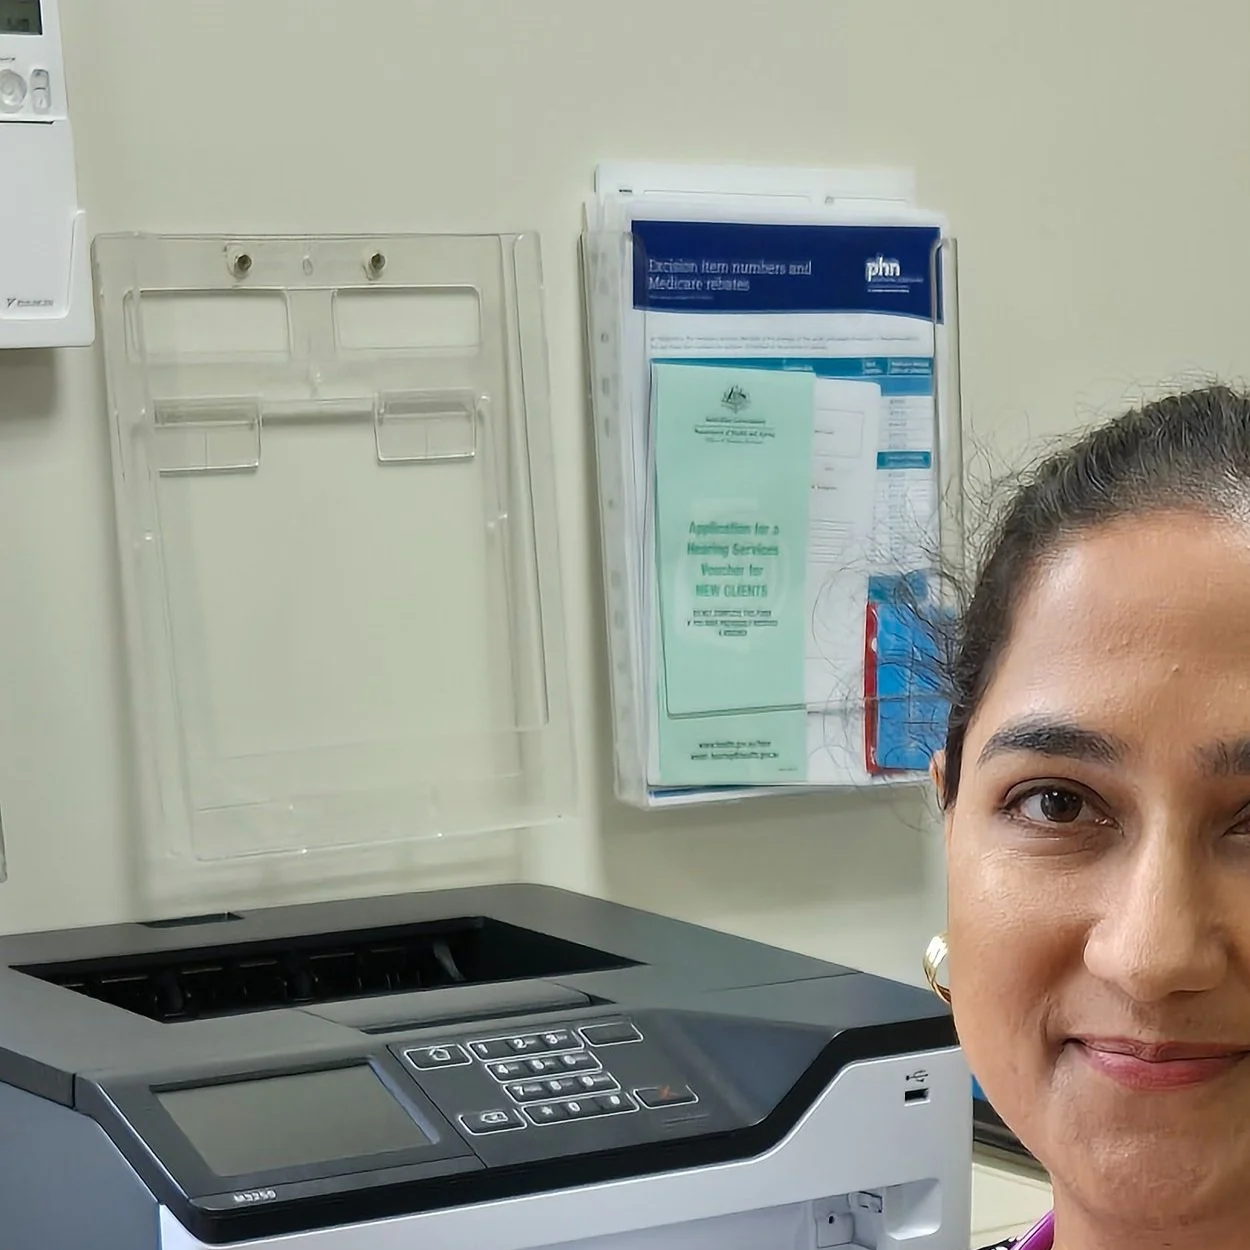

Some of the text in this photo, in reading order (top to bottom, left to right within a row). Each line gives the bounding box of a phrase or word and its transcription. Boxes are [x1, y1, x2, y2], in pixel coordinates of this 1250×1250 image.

[649, 258, 812, 275] Excision item numbers and
[865, 256, 901, 282] phn
[648, 275, 750, 291] Medicare rebates
[689, 520, 751, 537] Application
[687, 542, 779, 558] Hearing Services
[701, 563, 745, 576] Voucher
[695, 584, 768, 597] NEW CLIENTS
[478, 1044, 488, 1054] 1
[513, 1039, 526, 1049] 2
[498, 1064, 509, 1074] 4
[513, 1086, 524, 1096] 7
